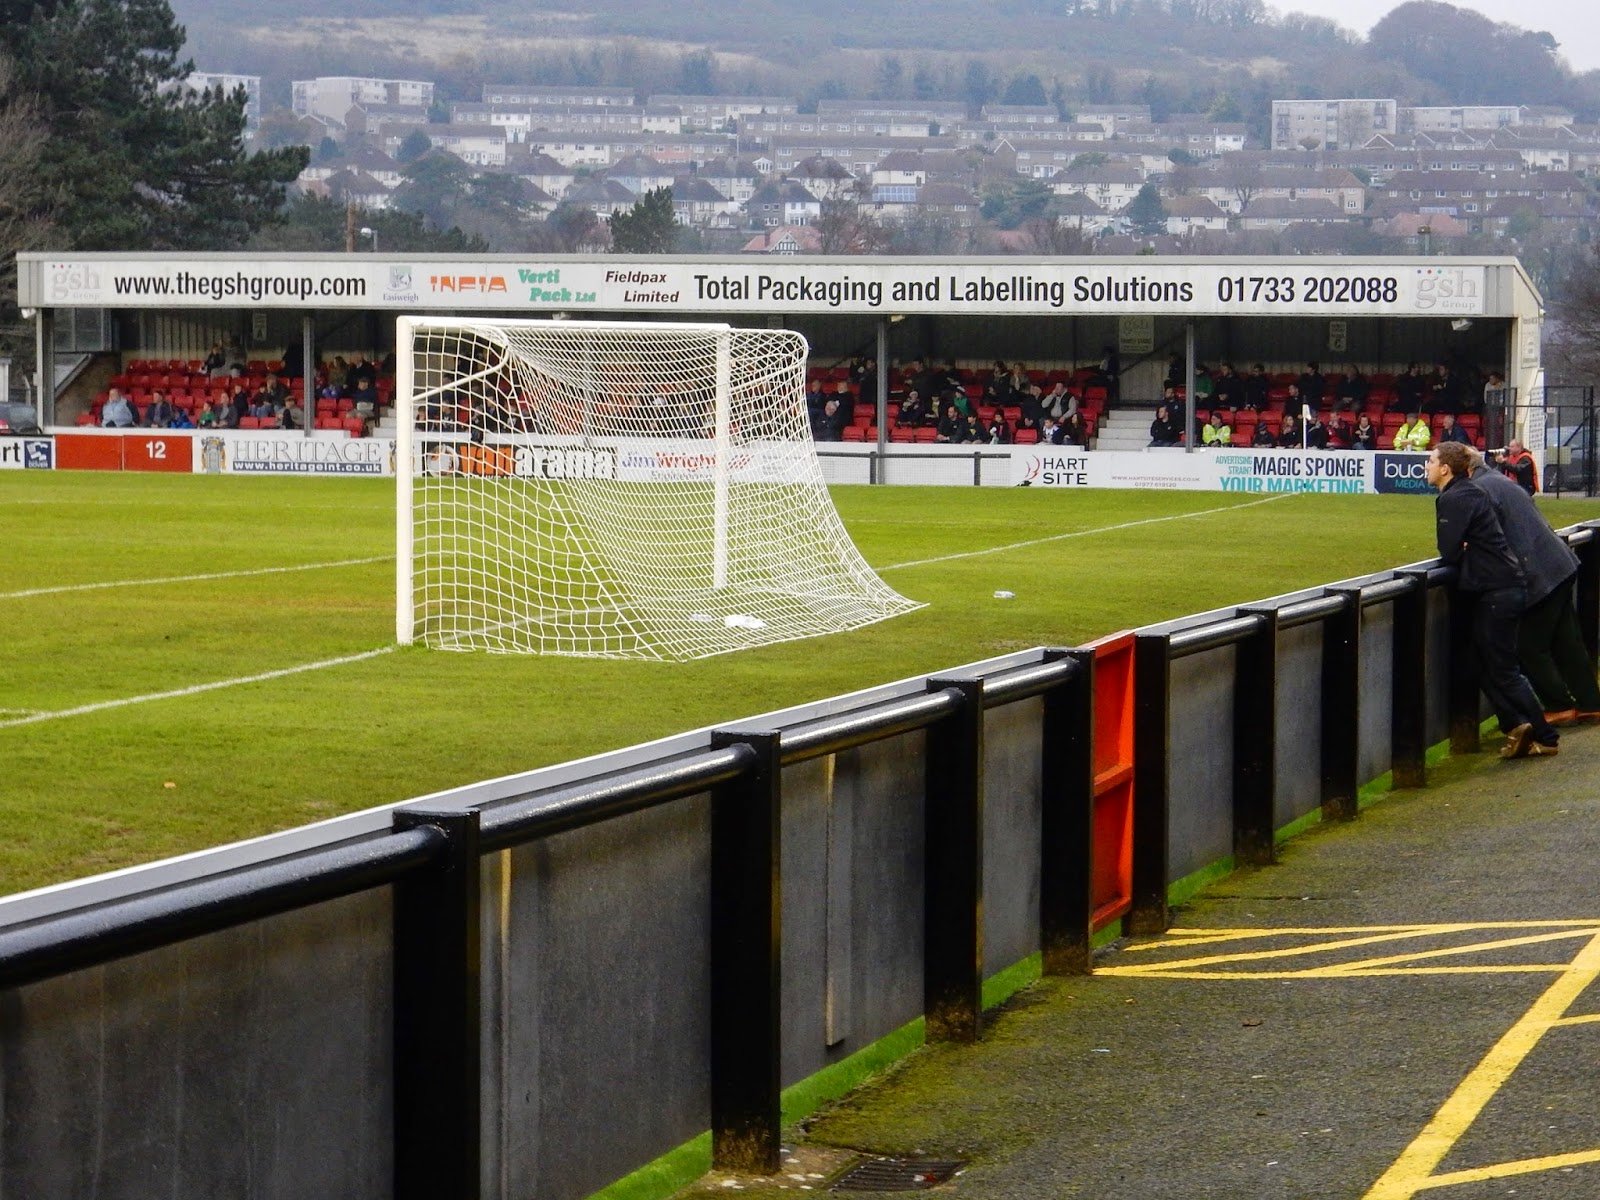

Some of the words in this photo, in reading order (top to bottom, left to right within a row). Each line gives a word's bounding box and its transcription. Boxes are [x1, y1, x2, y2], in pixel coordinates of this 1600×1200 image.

[518, 269, 560, 284] Verti
[605, 270, 667, 285] Fieldpax
[114, 272, 366, 300] www.thegshgroup.com
[694, 275, 750, 300] Total
[758, 275, 882, 306] Packaging
[892, 277, 940, 302] and
[950, 276, 1065, 307] Labelling
[1074, 276, 1194, 303] Solutions
[1218, 277, 1295, 303] 01733
[1303, 277, 1398, 304] 202088
[1414, 269, 1478, 309] gsh
[529, 287, 572, 302] Pack
[575, 292, 597, 302] Ltd
[624, 290, 680, 303] Limited
[1442, 300, 1476, 311] Group
[146, 441, 166, 459] 12
[233, 440, 382, 462] HERITAGE
[234, 461, 381, 472] www.heritageint.co.uk
[656, 452, 722, 472] Wrigh
[1043, 458, 1088, 470] HART
[1215, 456, 1252, 464] ADVERTISING
[1253, 456, 1301, 476] MAGIC
[1305, 457, 1365, 477] SPONGE
[1228, 466, 1252, 474] STRAIN?
[1043, 472, 1088, 485] SITE
[1219, 476, 1264, 491] YOUR
[1267, 478, 1365, 493] MARKETING
[1394, 480, 1426, 488] MEDIA
